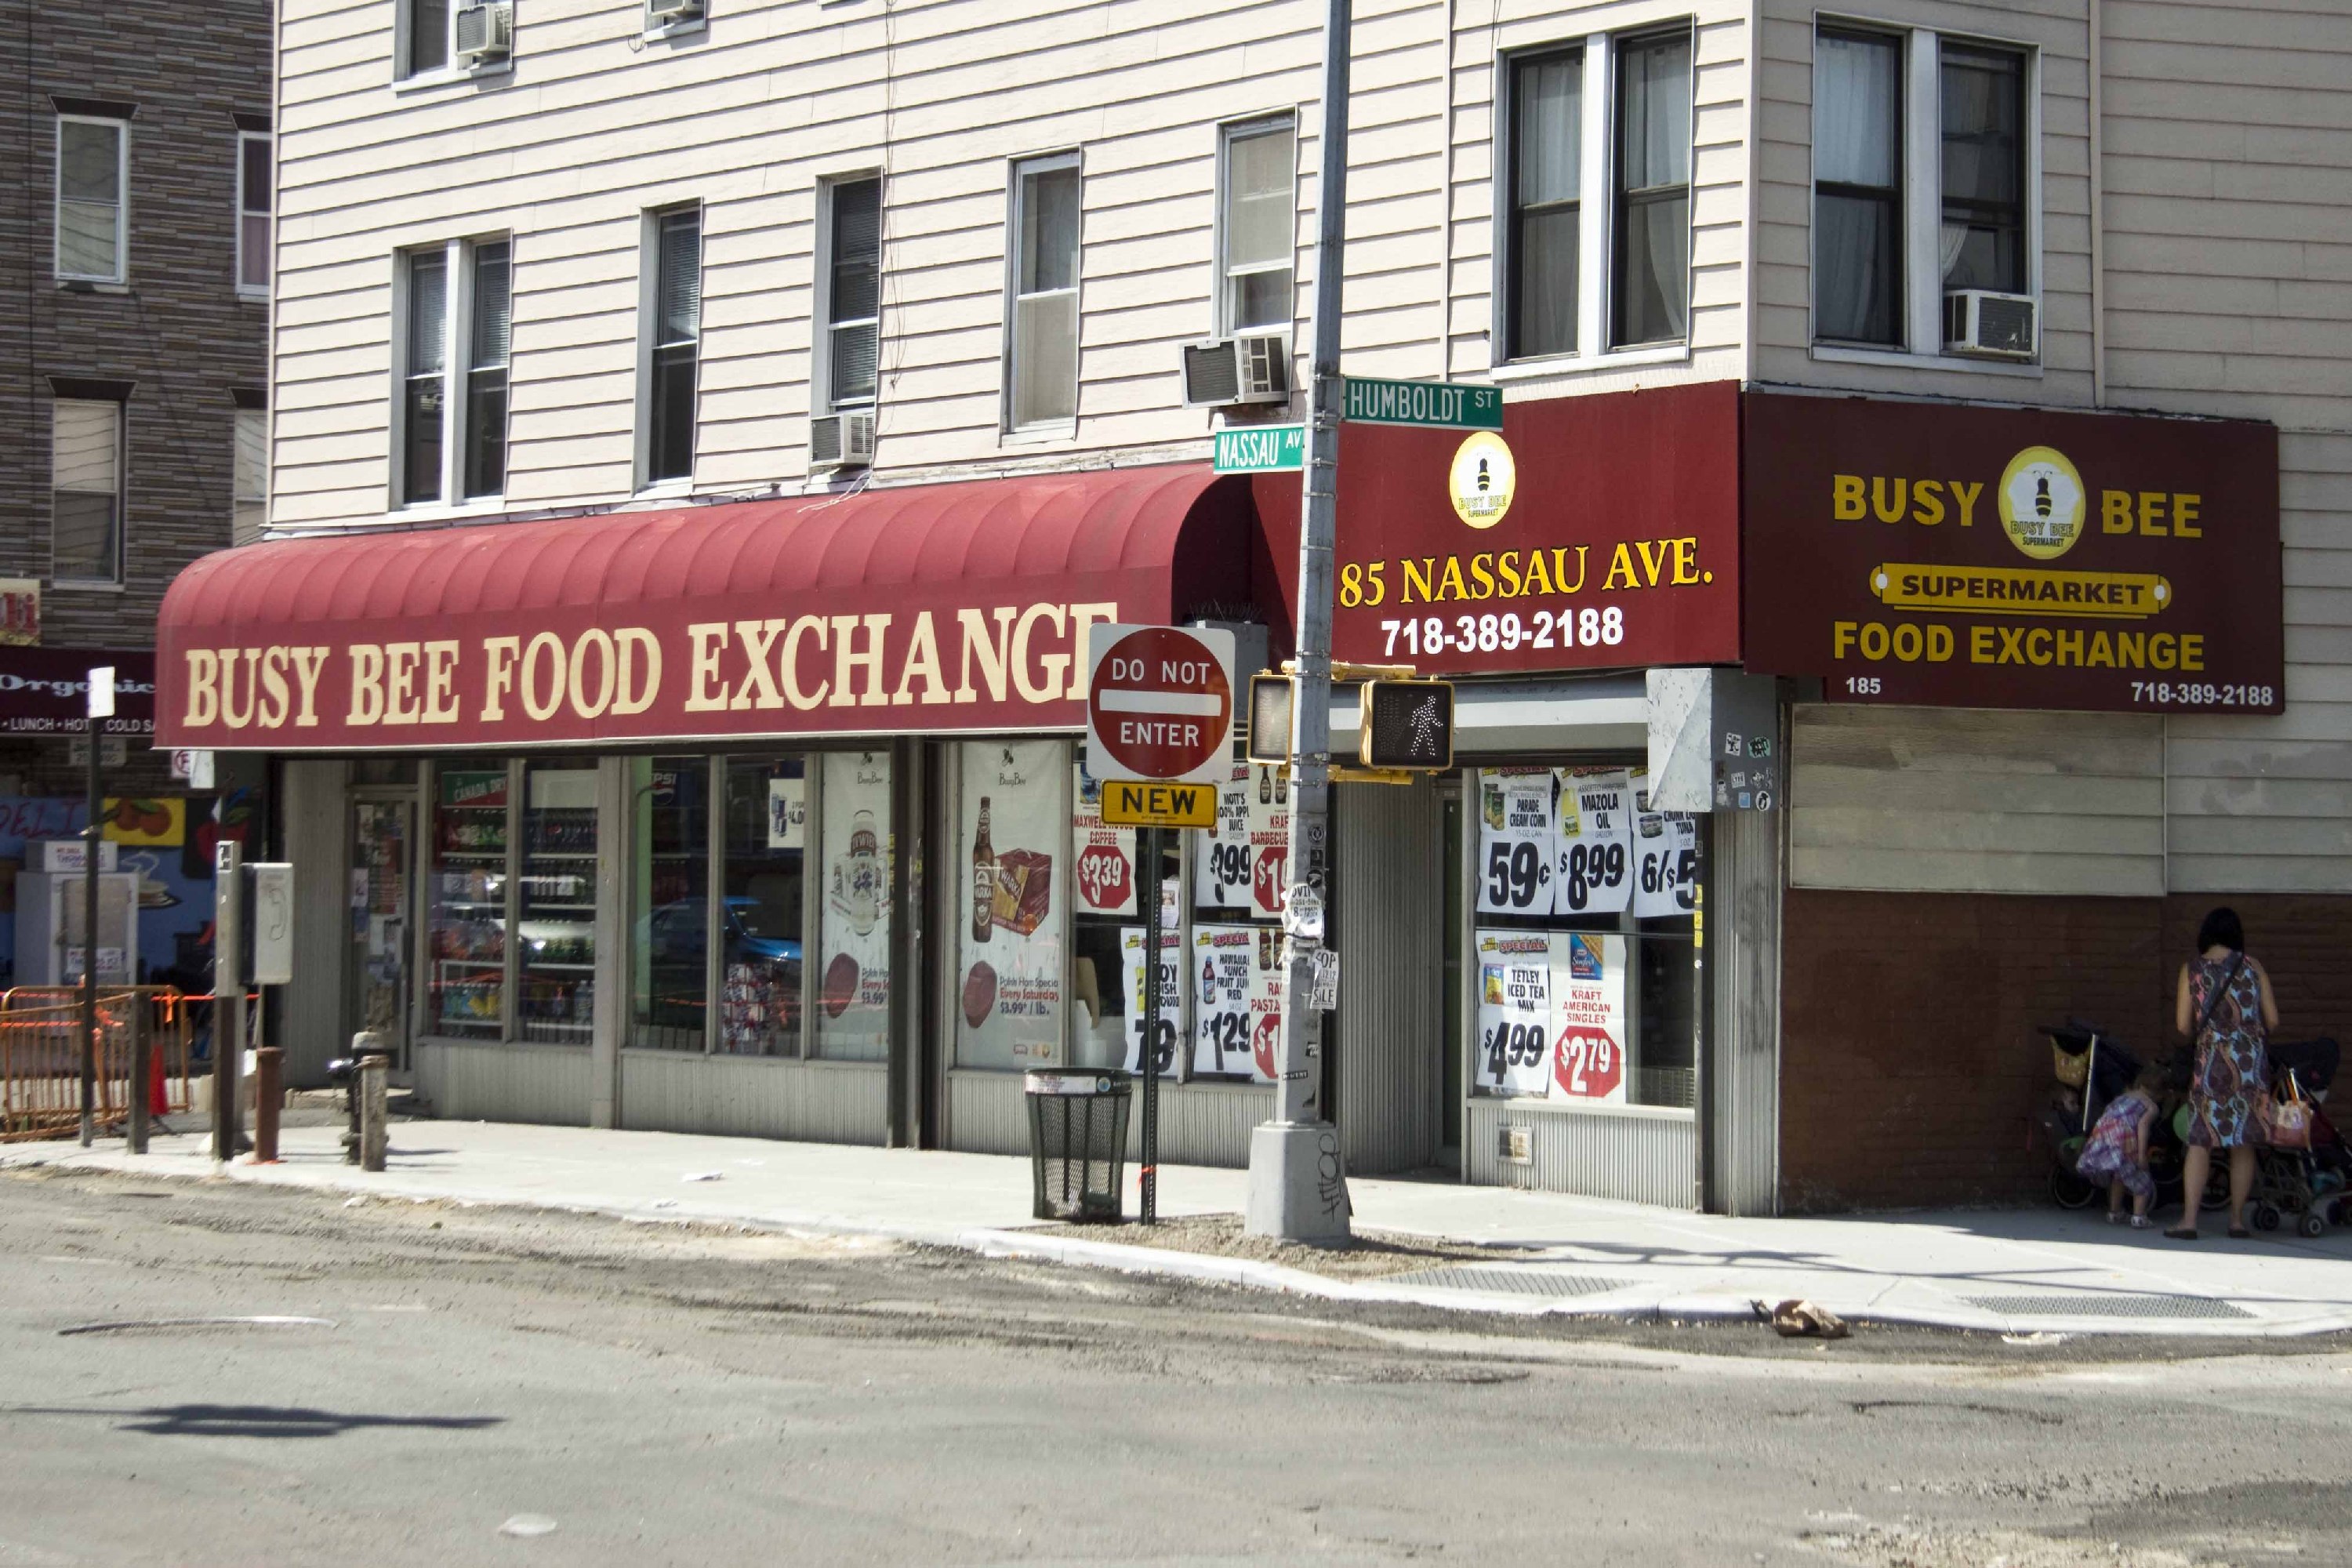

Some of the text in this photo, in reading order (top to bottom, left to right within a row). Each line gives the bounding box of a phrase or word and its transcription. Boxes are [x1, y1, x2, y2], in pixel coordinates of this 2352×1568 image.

[1350, 383, 1494, 422] HUMBOLDT ST
[1218, 430, 1303, 468] NASSAU AV
[1458, 496, 1485, 510] BUSY
[1832, 474, 2202, 538] BUSY BEE
[1468, 508, 1499, 518] SUPERMARKET
[2010, 521, 2074, 537] BUSY BEE
[2022, 537, 2065, 547] SUPERMARKET
[1333, 536, 1714, 608] 85 NASSAU AVE.
[1901, 575, 2144, 604] SUPERMARKET
[1381, 607, 1624, 657] 718-389-2188
[1833, 621, 2205, 671] FOOD EXCHANGE
[183, 645, 330, 729] BUSY
[346, 640, 460, 726] BEE
[480, 626, 662, 722] FOOD
[1112, 658, 1210, 684] DO NOT
[1845, 677, 2273, 706] 185 718-389-2188
[10, 717, 54, 731] LUNCH
[64, 718, 91, 731] HOT
[105, 719, 141, 731] COLD
[1120, 721, 1200, 747] ENTER
[1122, 786, 1197, 815] NEW
[1224, 793, 1245, 805] MOTT'S
[1516, 799, 1540, 812] PARADE
[1581, 793, 1619, 811] MAZOLA
[1073, 814, 1106, 829] MAXWEL
[1229, 818, 1244, 831] JUICE
[1509, 814, 1546, 827] CREAM CORN
[1596, 812, 1610, 829] OIL
[1675, 822, 1694, 835] TUNA
[1090, 831, 1117, 844] COFFEE
[1250, 831, 1288, 846] BARBECUE
[1500, 940, 1546, 952] SPECIAL
[1219, 954, 1250, 966] HAWAIIA
[1160, 964, 1178, 982] OY
[1224, 966, 1247, 977] PUNCH
[1512, 969, 1539, 984] TETLEY
[1160, 982, 1177, 995] ISH
[1217, 978, 1234, 988] FRUIT
[1000, 987, 1059, 1002] Every Saturday
[1227, 989, 1242, 1000] RED
[1508, 985, 1544, 1000] ICED TEA
[1571, 989, 1602, 1000] KRAFT
[1250, 998, 1280, 1012] PASTA
[1517, 999, 1535, 1013] MIX
[1563, 1001, 1610, 1013] AMERICAN
[1566, 1012, 1606, 1024] SINGLES
